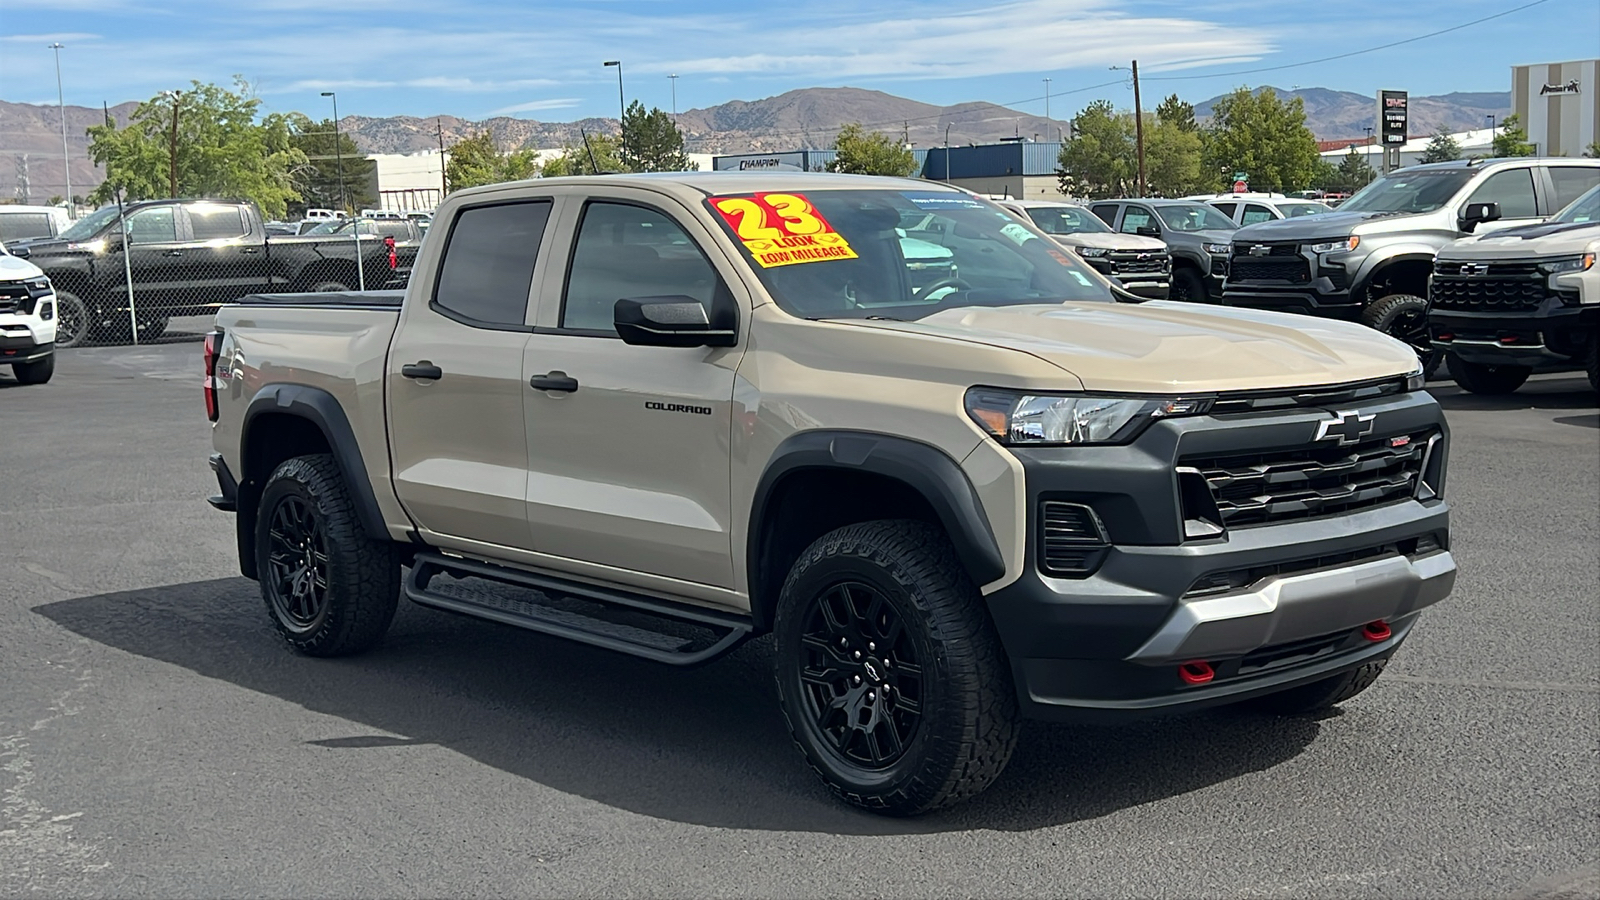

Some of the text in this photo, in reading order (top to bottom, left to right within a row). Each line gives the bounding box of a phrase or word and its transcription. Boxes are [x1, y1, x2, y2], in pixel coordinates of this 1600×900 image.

[1386, 98, 1406, 107] GMC
[739, 158, 780, 171] CHAMPION
[717, 194, 826, 240] 23
[772, 235, 820, 249] LOOK
[760, 246, 849, 264] LOW MILEAGE
[645, 401, 712, 415] COLORADO
